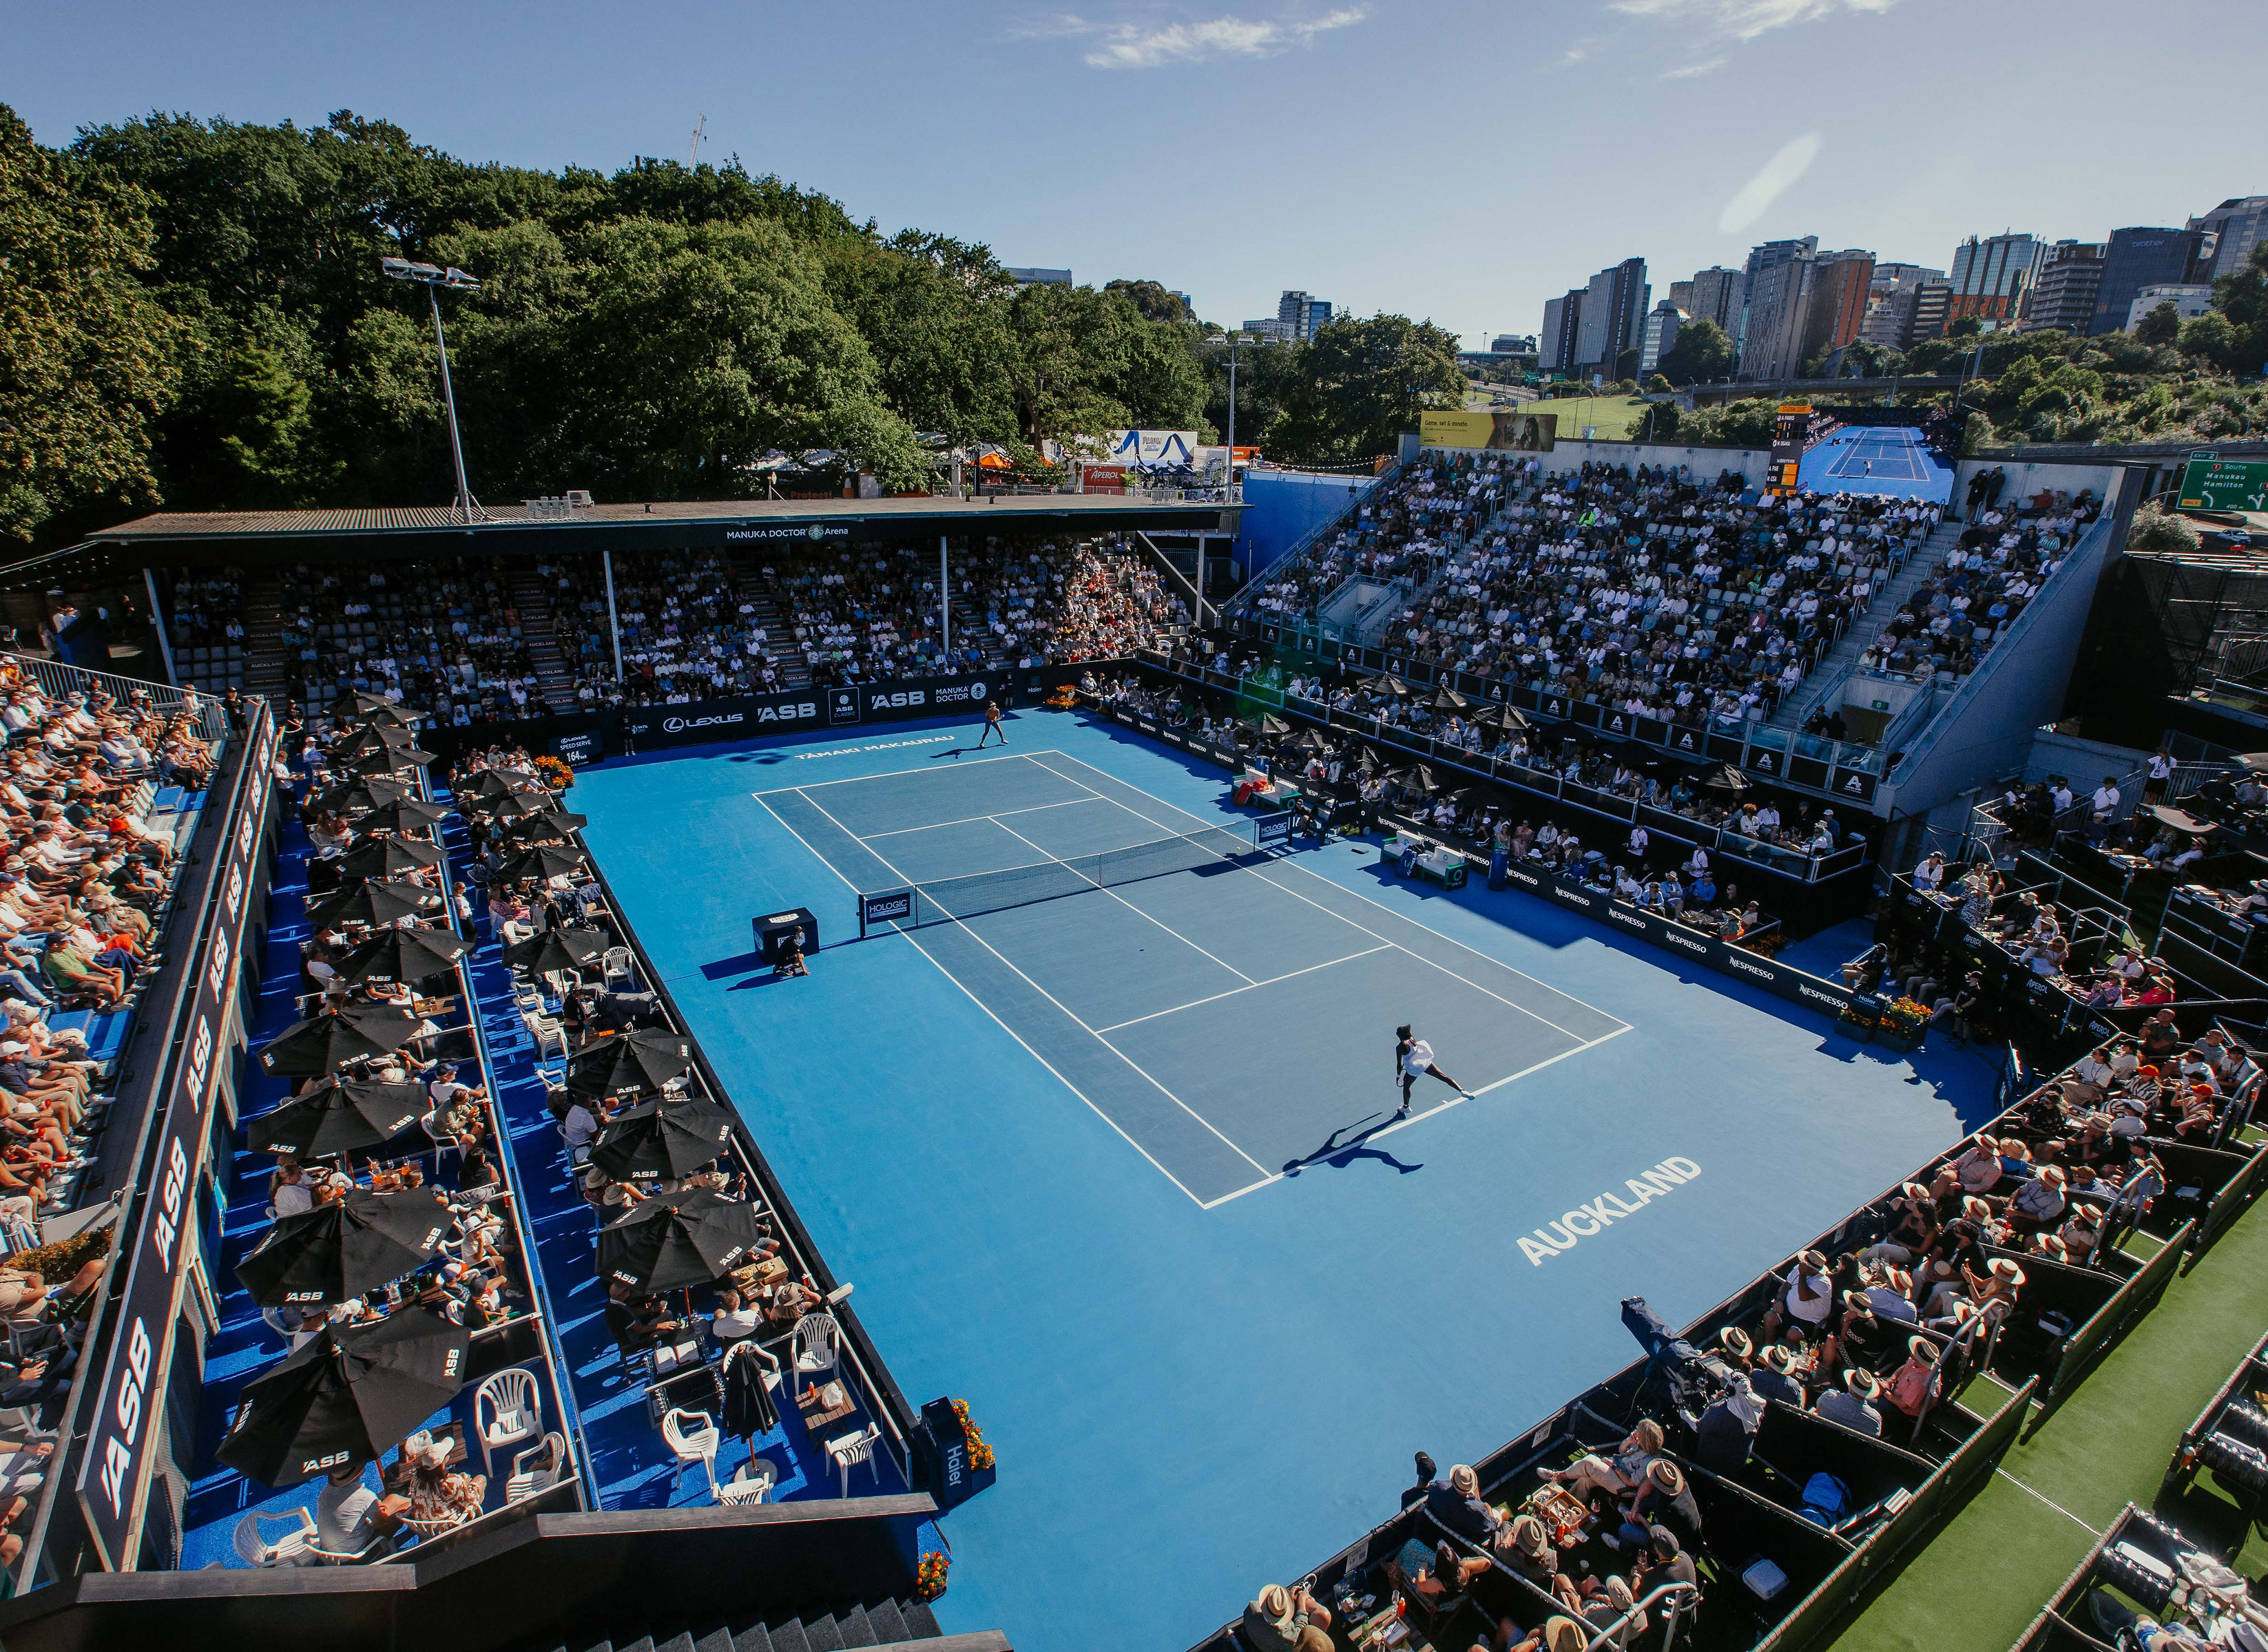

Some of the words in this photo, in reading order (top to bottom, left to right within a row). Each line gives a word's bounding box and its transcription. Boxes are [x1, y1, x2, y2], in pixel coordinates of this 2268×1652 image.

[1090, 470, 1119, 479] APEROL
[727, 530, 767, 539] MANUKA
[769, 529, 807, 538] DOCTOR
[824, 527, 849, 536] Arena
[936, 687, 968, 696] MANUKA
[936, 693, 968, 702] DOCTOR
[872, 691, 926, 710] ASB
[686, 713, 744, 727] LEXUS
[758, 702, 816, 723] ASB
[1139, 721, 1156, 732] NESPRESSO
[1163, 730, 1180, 742] NESPRESSO
[560, 742, 576, 751] SPEED
[795, 748, 861, 760] TĀMAKI
[864, 735, 956, 751] MAKAURAU
[1189, 740, 1207, 753] NESPRESSO
[566, 751, 580, 762] 164
[1215, 751, 1234, 764] NESPRESSO
[1262, 822, 1287, 833] HOLOGIC
[1377, 815, 1404, 831] NESPRESSO
[1417, 831, 1446, 847] NESPRESSO
[1460, 848, 1490, 866] NESPRESSO
[1506, 868, 1538, 886] NESPRESSO
[226, 862, 243, 924] ASB
[1555, 886, 1590, 907] NESPRESSO
[1906, 893, 1922, 906] APEROL
[869, 899, 908, 913] HOLOGIC
[1609, 906, 1646, 930] NESPRESSO
[1665, 930, 1707, 954] NESPRESSO
[1963, 934, 1982, 948] APEROL
[209, 926, 231, 1004] ASB
[1729, 956, 1774, 981] NESPRESSO
[2026, 979, 2048, 994] APEROL
[1799, 983, 1849, 1010] NESPRESSO
[1858, 994, 1876, 1005] Haier
[2088, 1020, 2110, 1037] APEROL
[186, 1014, 212, 1115] ASB
[616, 1085, 641, 1094] ASB
[718, 1125, 730, 1142] ASB
[631, 1171, 658, 1179] ASB
[153, 1135, 189, 1274] ASB
[1515, 1156, 1703, 1267] AUCKLAND
[420, 1227, 442, 1251] ASB
[719, 1245, 742, 1266] ASB
[612, 1270, 639, 1285] ASB
[285, 1290, 324, 1302] ASB
[444, 1348, 461, 1377] ASB
[100, 1315, 153, 1520] ASB
[302, 1450, 350, 1474] ASB
[948, 1445, 964, 1486] Haier
